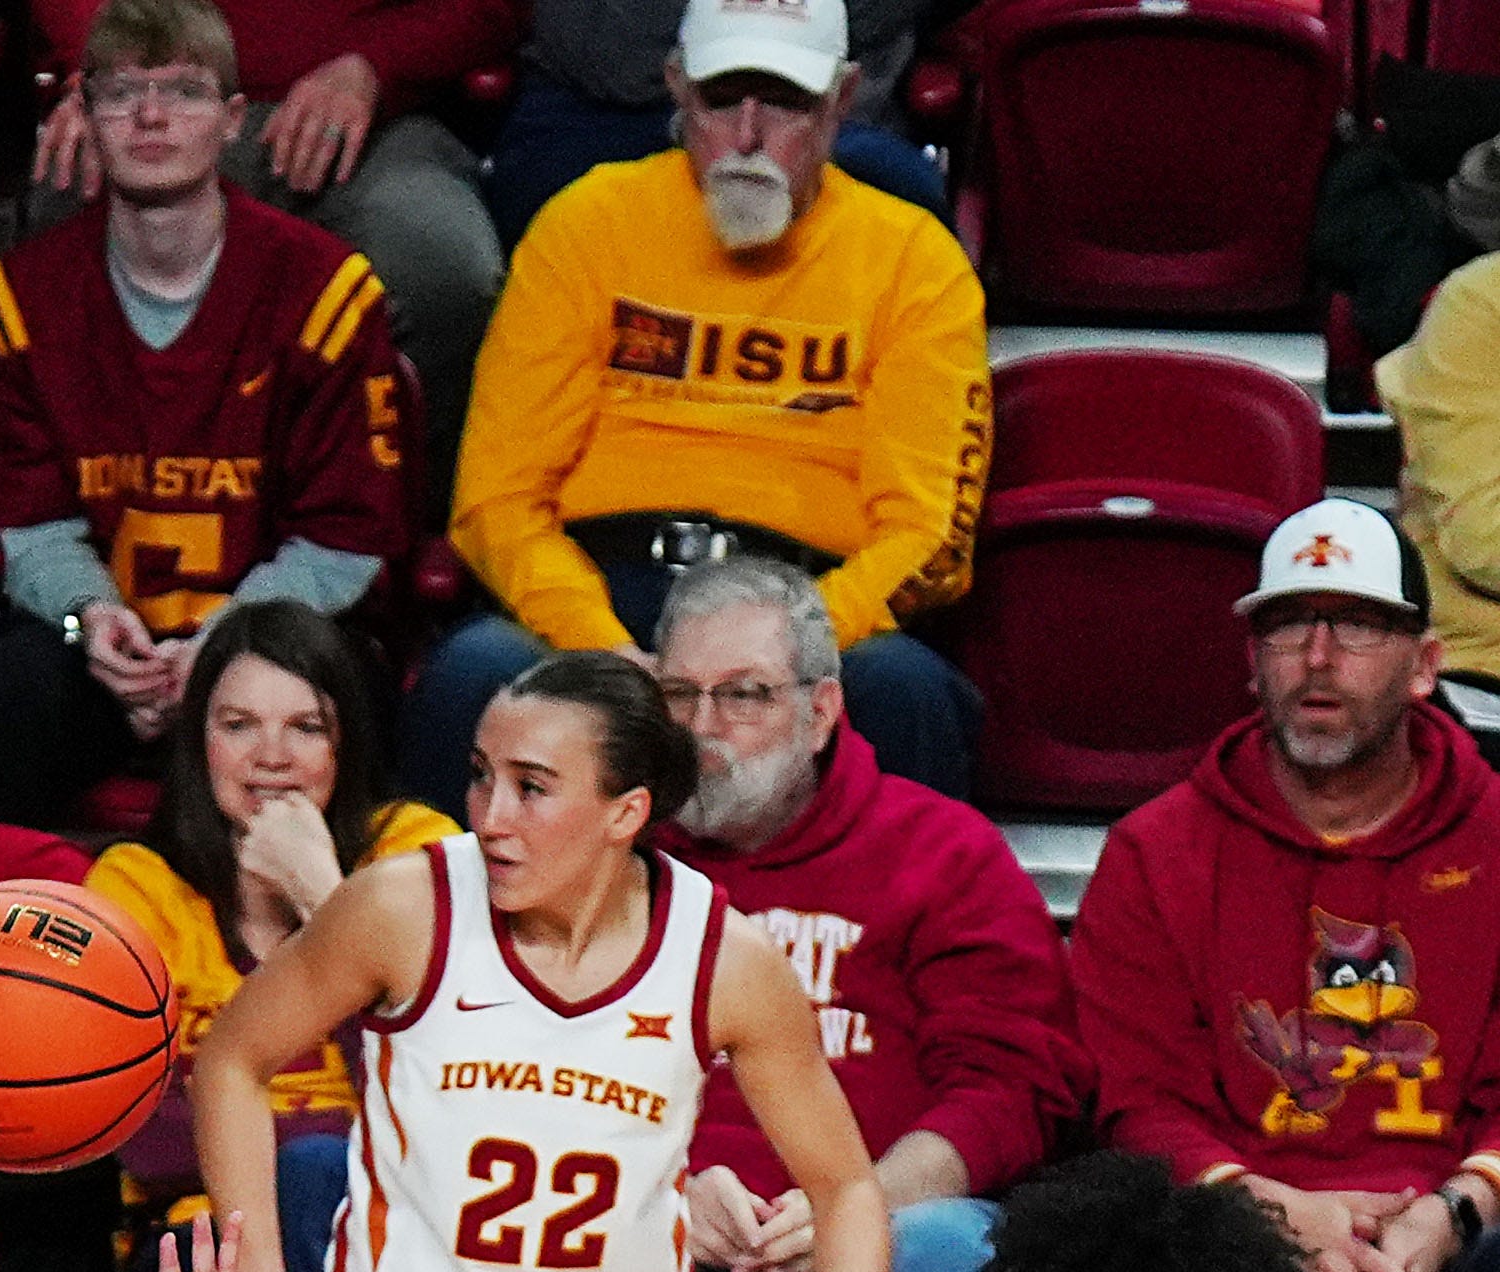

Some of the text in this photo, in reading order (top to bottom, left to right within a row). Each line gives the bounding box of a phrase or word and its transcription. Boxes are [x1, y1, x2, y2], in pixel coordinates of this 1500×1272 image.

[700, 323, 848, 383] ISU
[152, 456, 262, 499] STAT
[441, 1061, 667, 1124] IOWA STATE
[455, 1136, 620, 1269] 22
